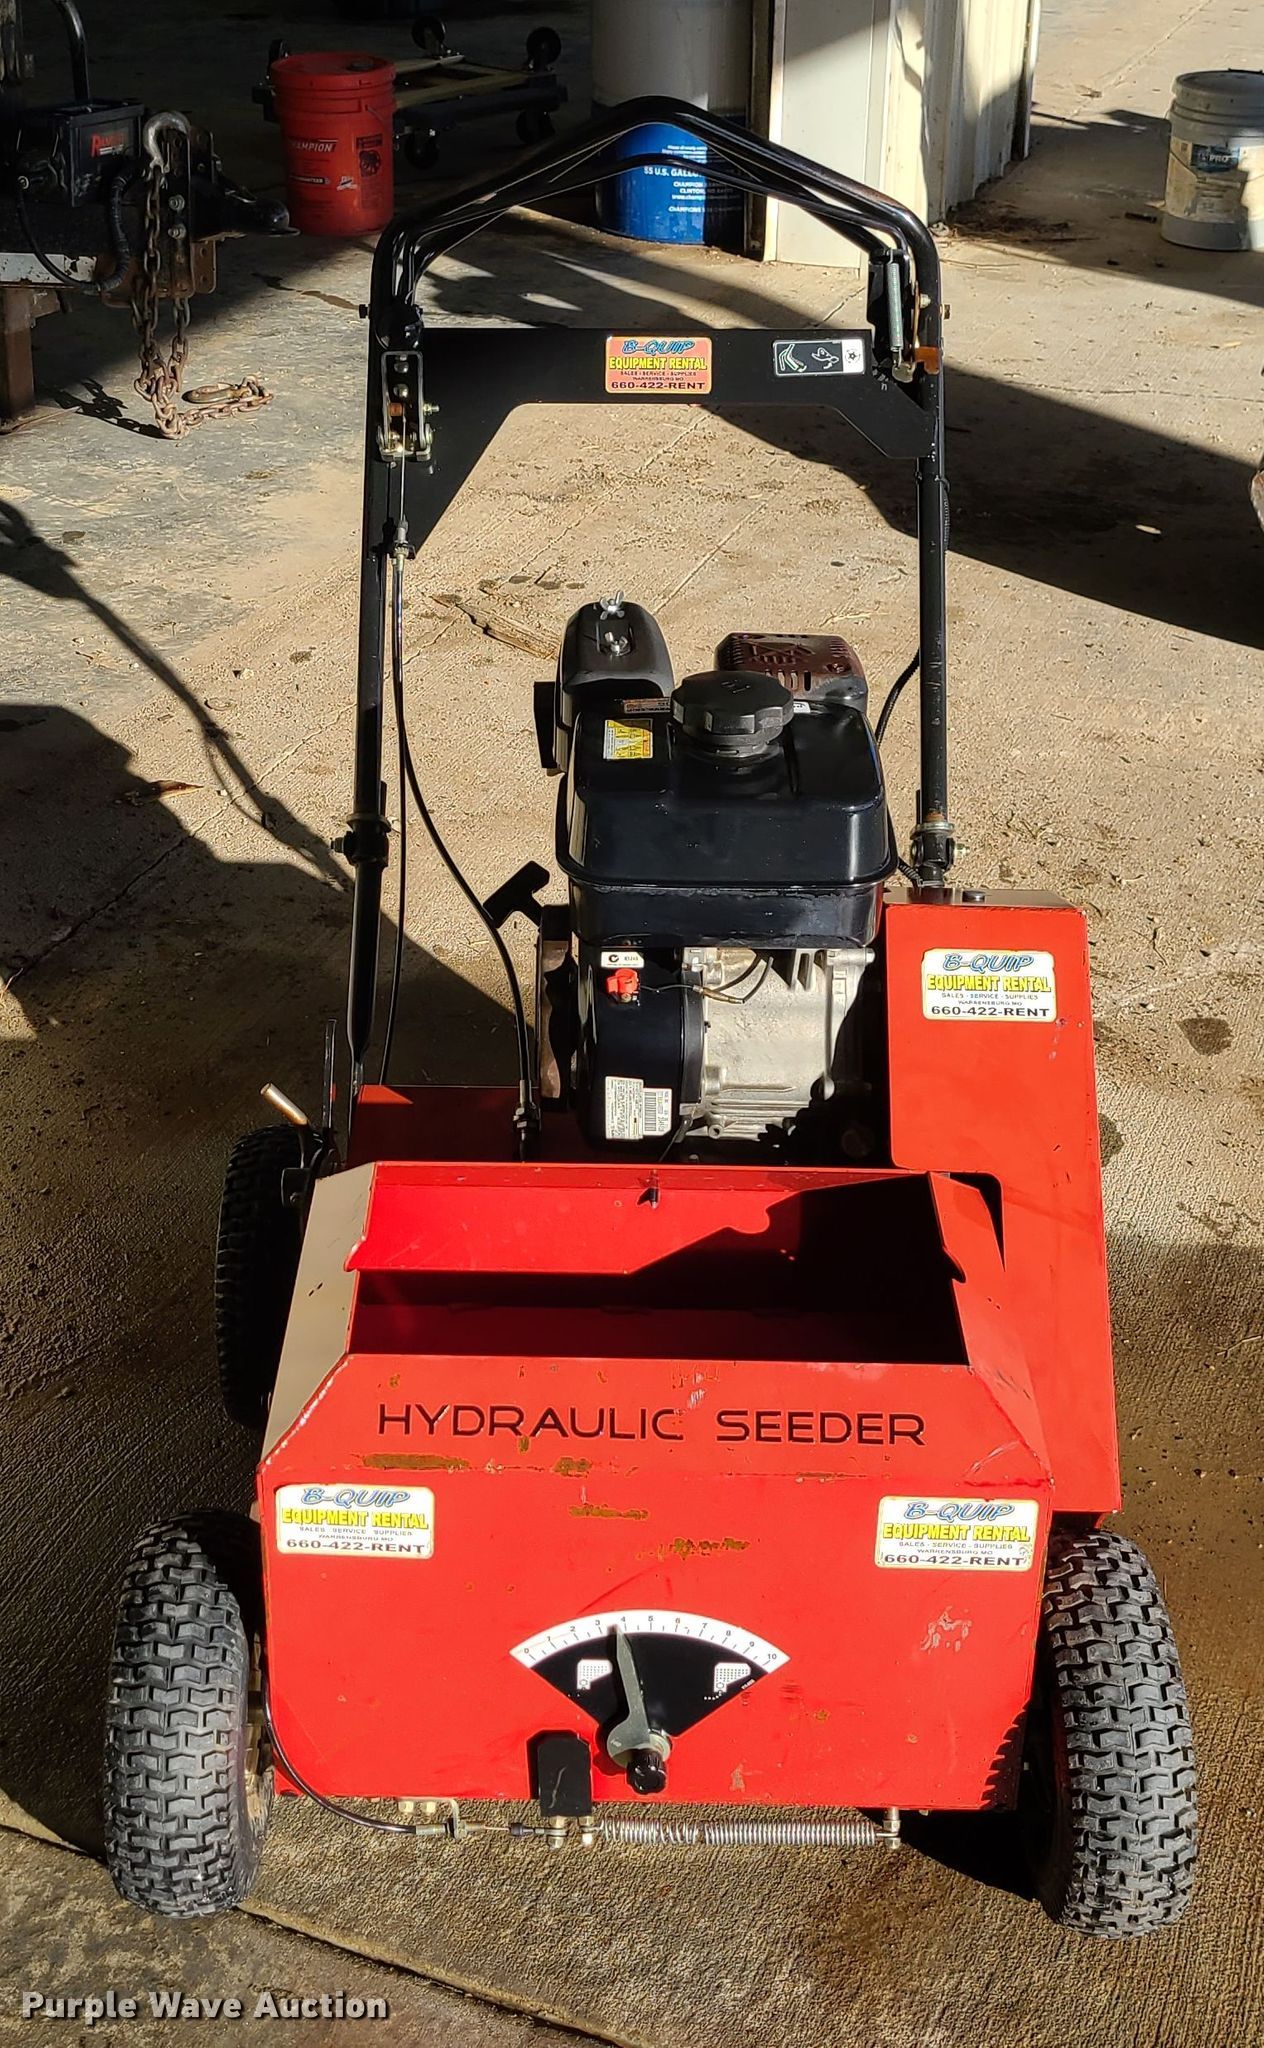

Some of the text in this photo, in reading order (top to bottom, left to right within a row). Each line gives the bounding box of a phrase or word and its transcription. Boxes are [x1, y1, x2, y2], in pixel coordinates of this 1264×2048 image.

[622, 339, 696, 356] B-QUIP
[609, 356, 708, 370] EQUIPMENT RENTAL
[611, 381, 705, 389] 660-422-RENT
[942, 953, 1034, 974] B-QUIP
[927, 974, 1051, 993] EQUIPMENT RENTAL
[931, 1006, 1050, 1017] 660-422-RENT
[377, 1403, 926, 1446] HYDRAULIC SEEDER
[301, 1487, 411, 1509] B-QUIP
[282, 1507, 429, 1530] EQUIPMENT RENTAL
[904, 1501, 1015, 1523] B-QUIP
[883, 1523, 1030, 1542] EQUIPMENT RENTAL
[287, 1539, 425, 1554] 660-422-RENT
[884, 1554, 1026, 1567] 660-422-RENT
